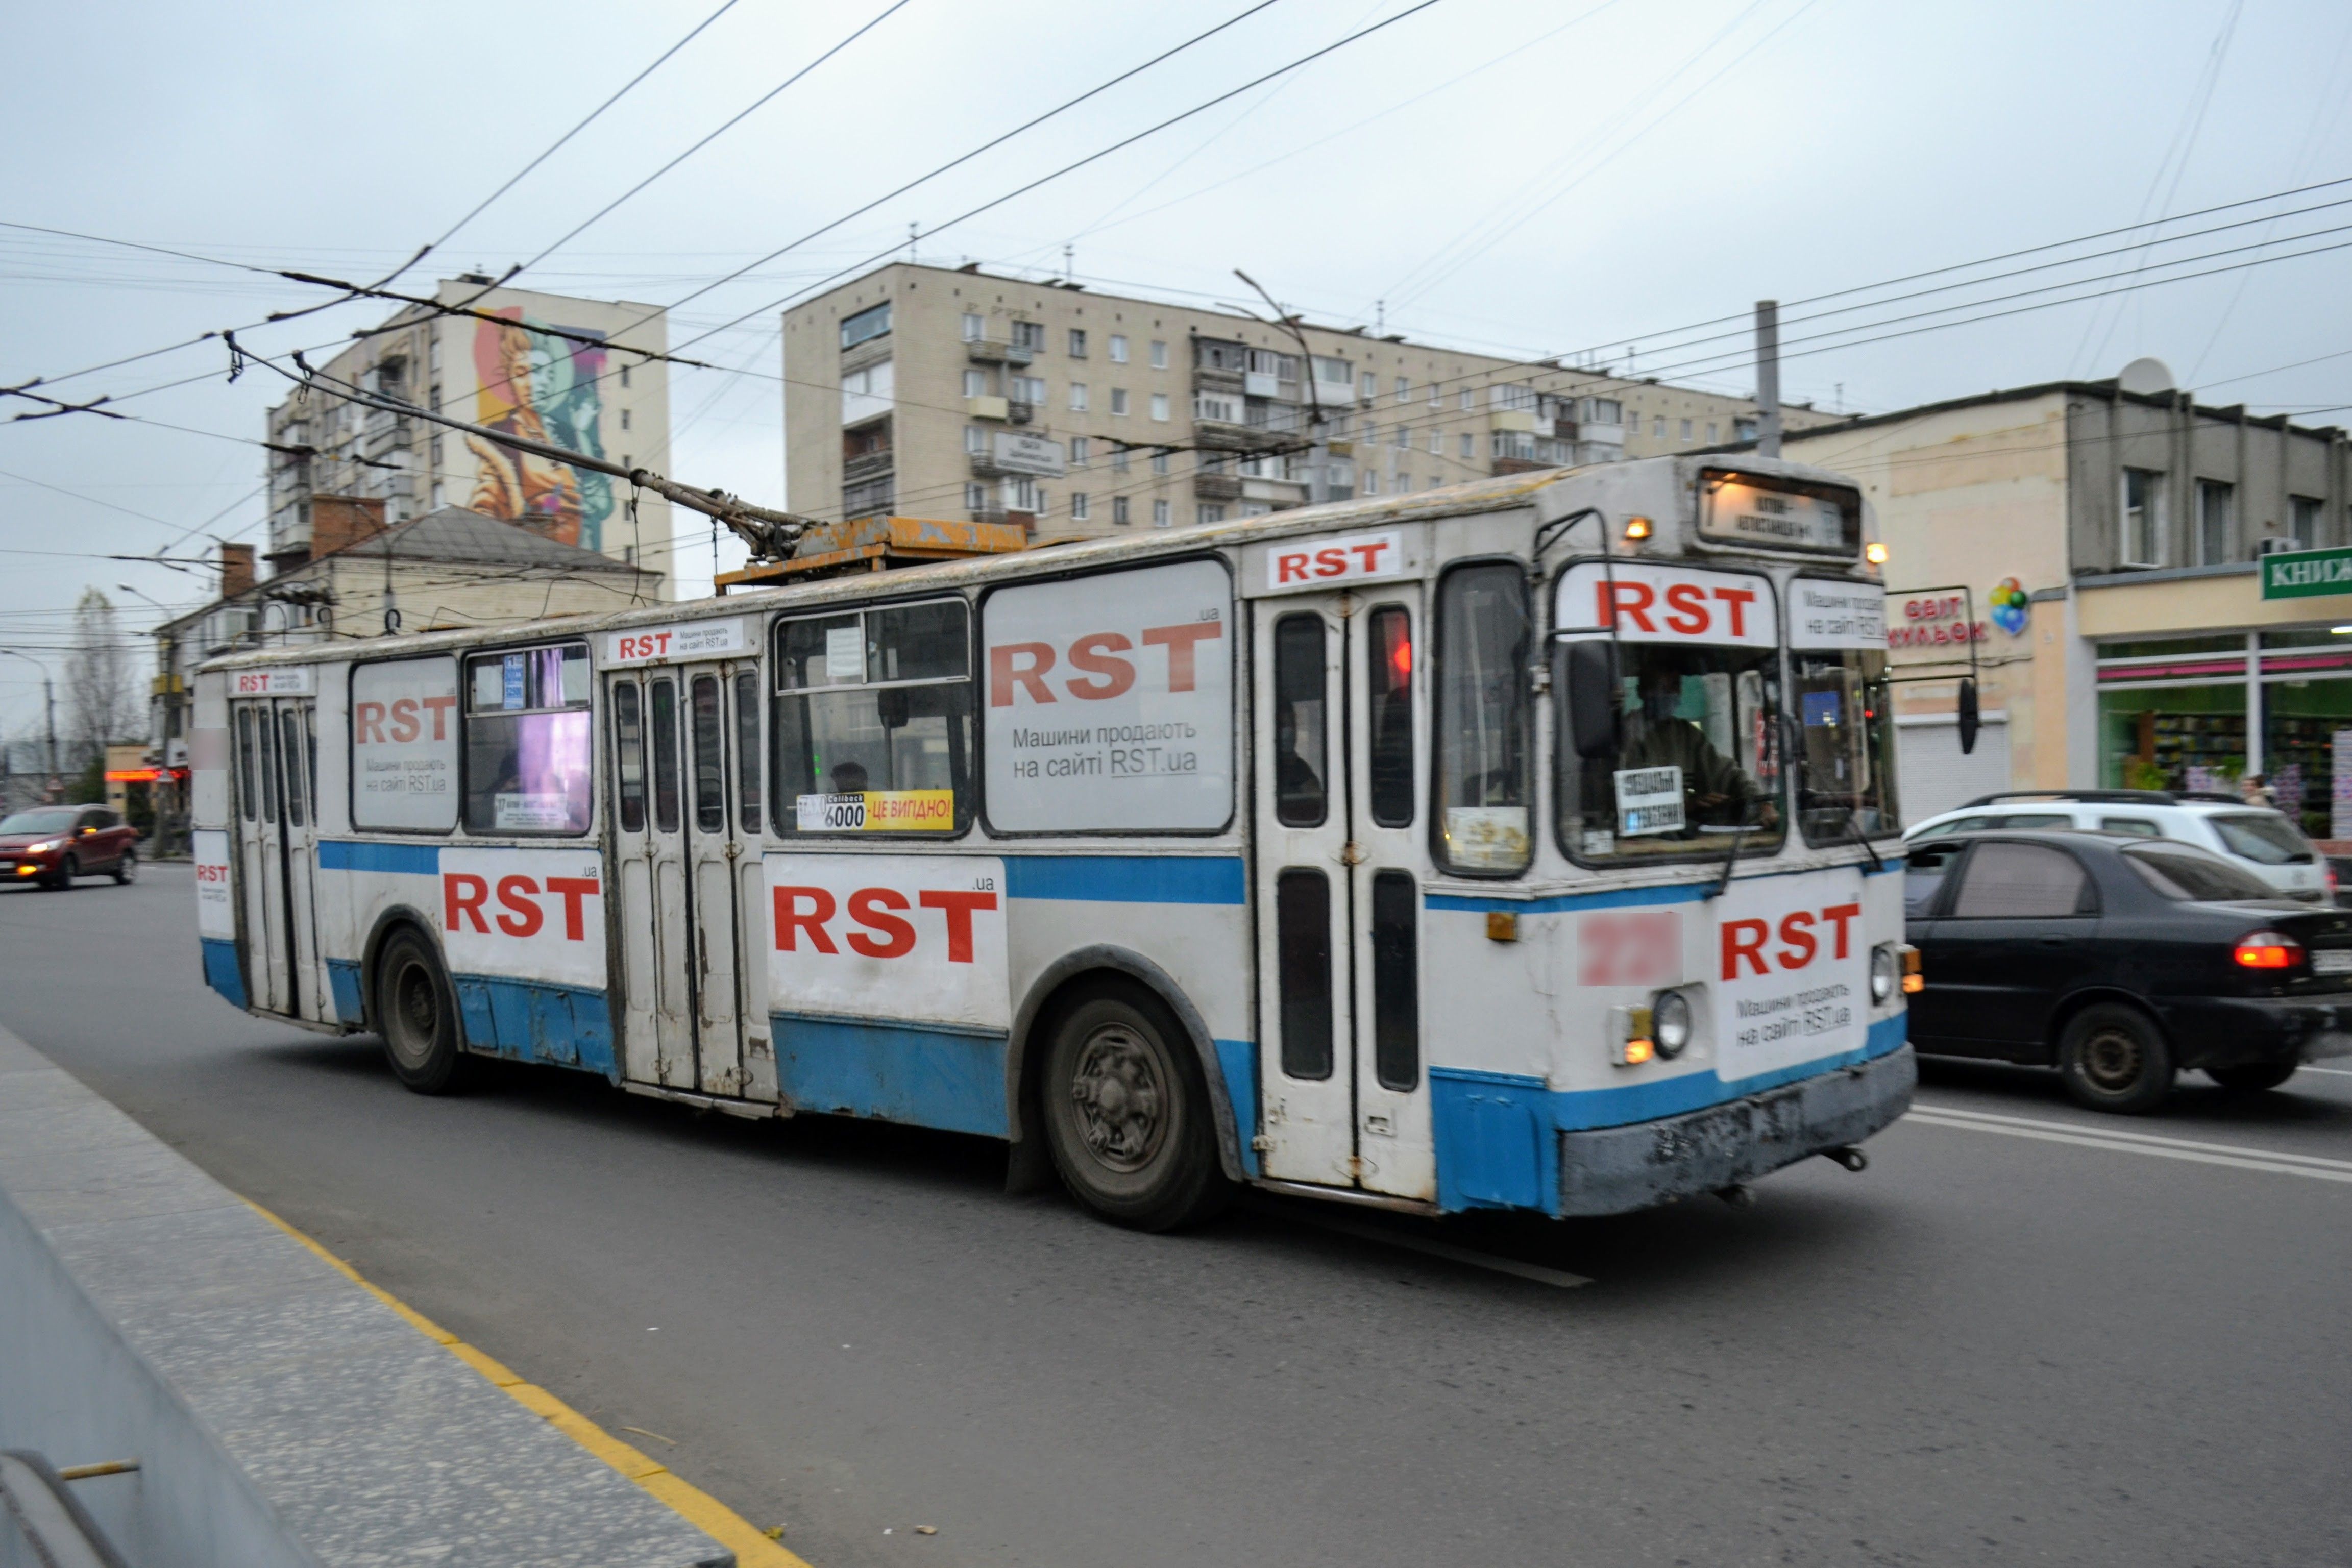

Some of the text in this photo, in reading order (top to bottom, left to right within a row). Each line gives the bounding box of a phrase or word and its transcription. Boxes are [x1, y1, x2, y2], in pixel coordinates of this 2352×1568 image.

[1279, 542, 1389, 583] RST
[1596, 581, 1755, 636] RST
[1905, 596, 1963, 619] СВІТ
[620, 632, 672, 659] RST
[680, 627, 728, 639] Машини продають
[990, 621, 1222, 707] RST
[240, 674, 270, 691] RST
[357, 696, 457, 744] RST
[1013, 722, 1197, 748] Машини продають
[1014, 748, 1197, 779] на сайті RST.ua
[827, 794, 864, 802] Callback
[893, 799, 951, 820] ВИГІДНО!
[825, 804, 864, 827] 6000
[197, 865, 228, 883] RST
[581, 866, 597, 877] .ua
[972, 878, 994, 891] .ua
[444, 873, 600, 941] RST
[773, 886, 998, 963] RST
[1721, 902, 1861, 981] RST
